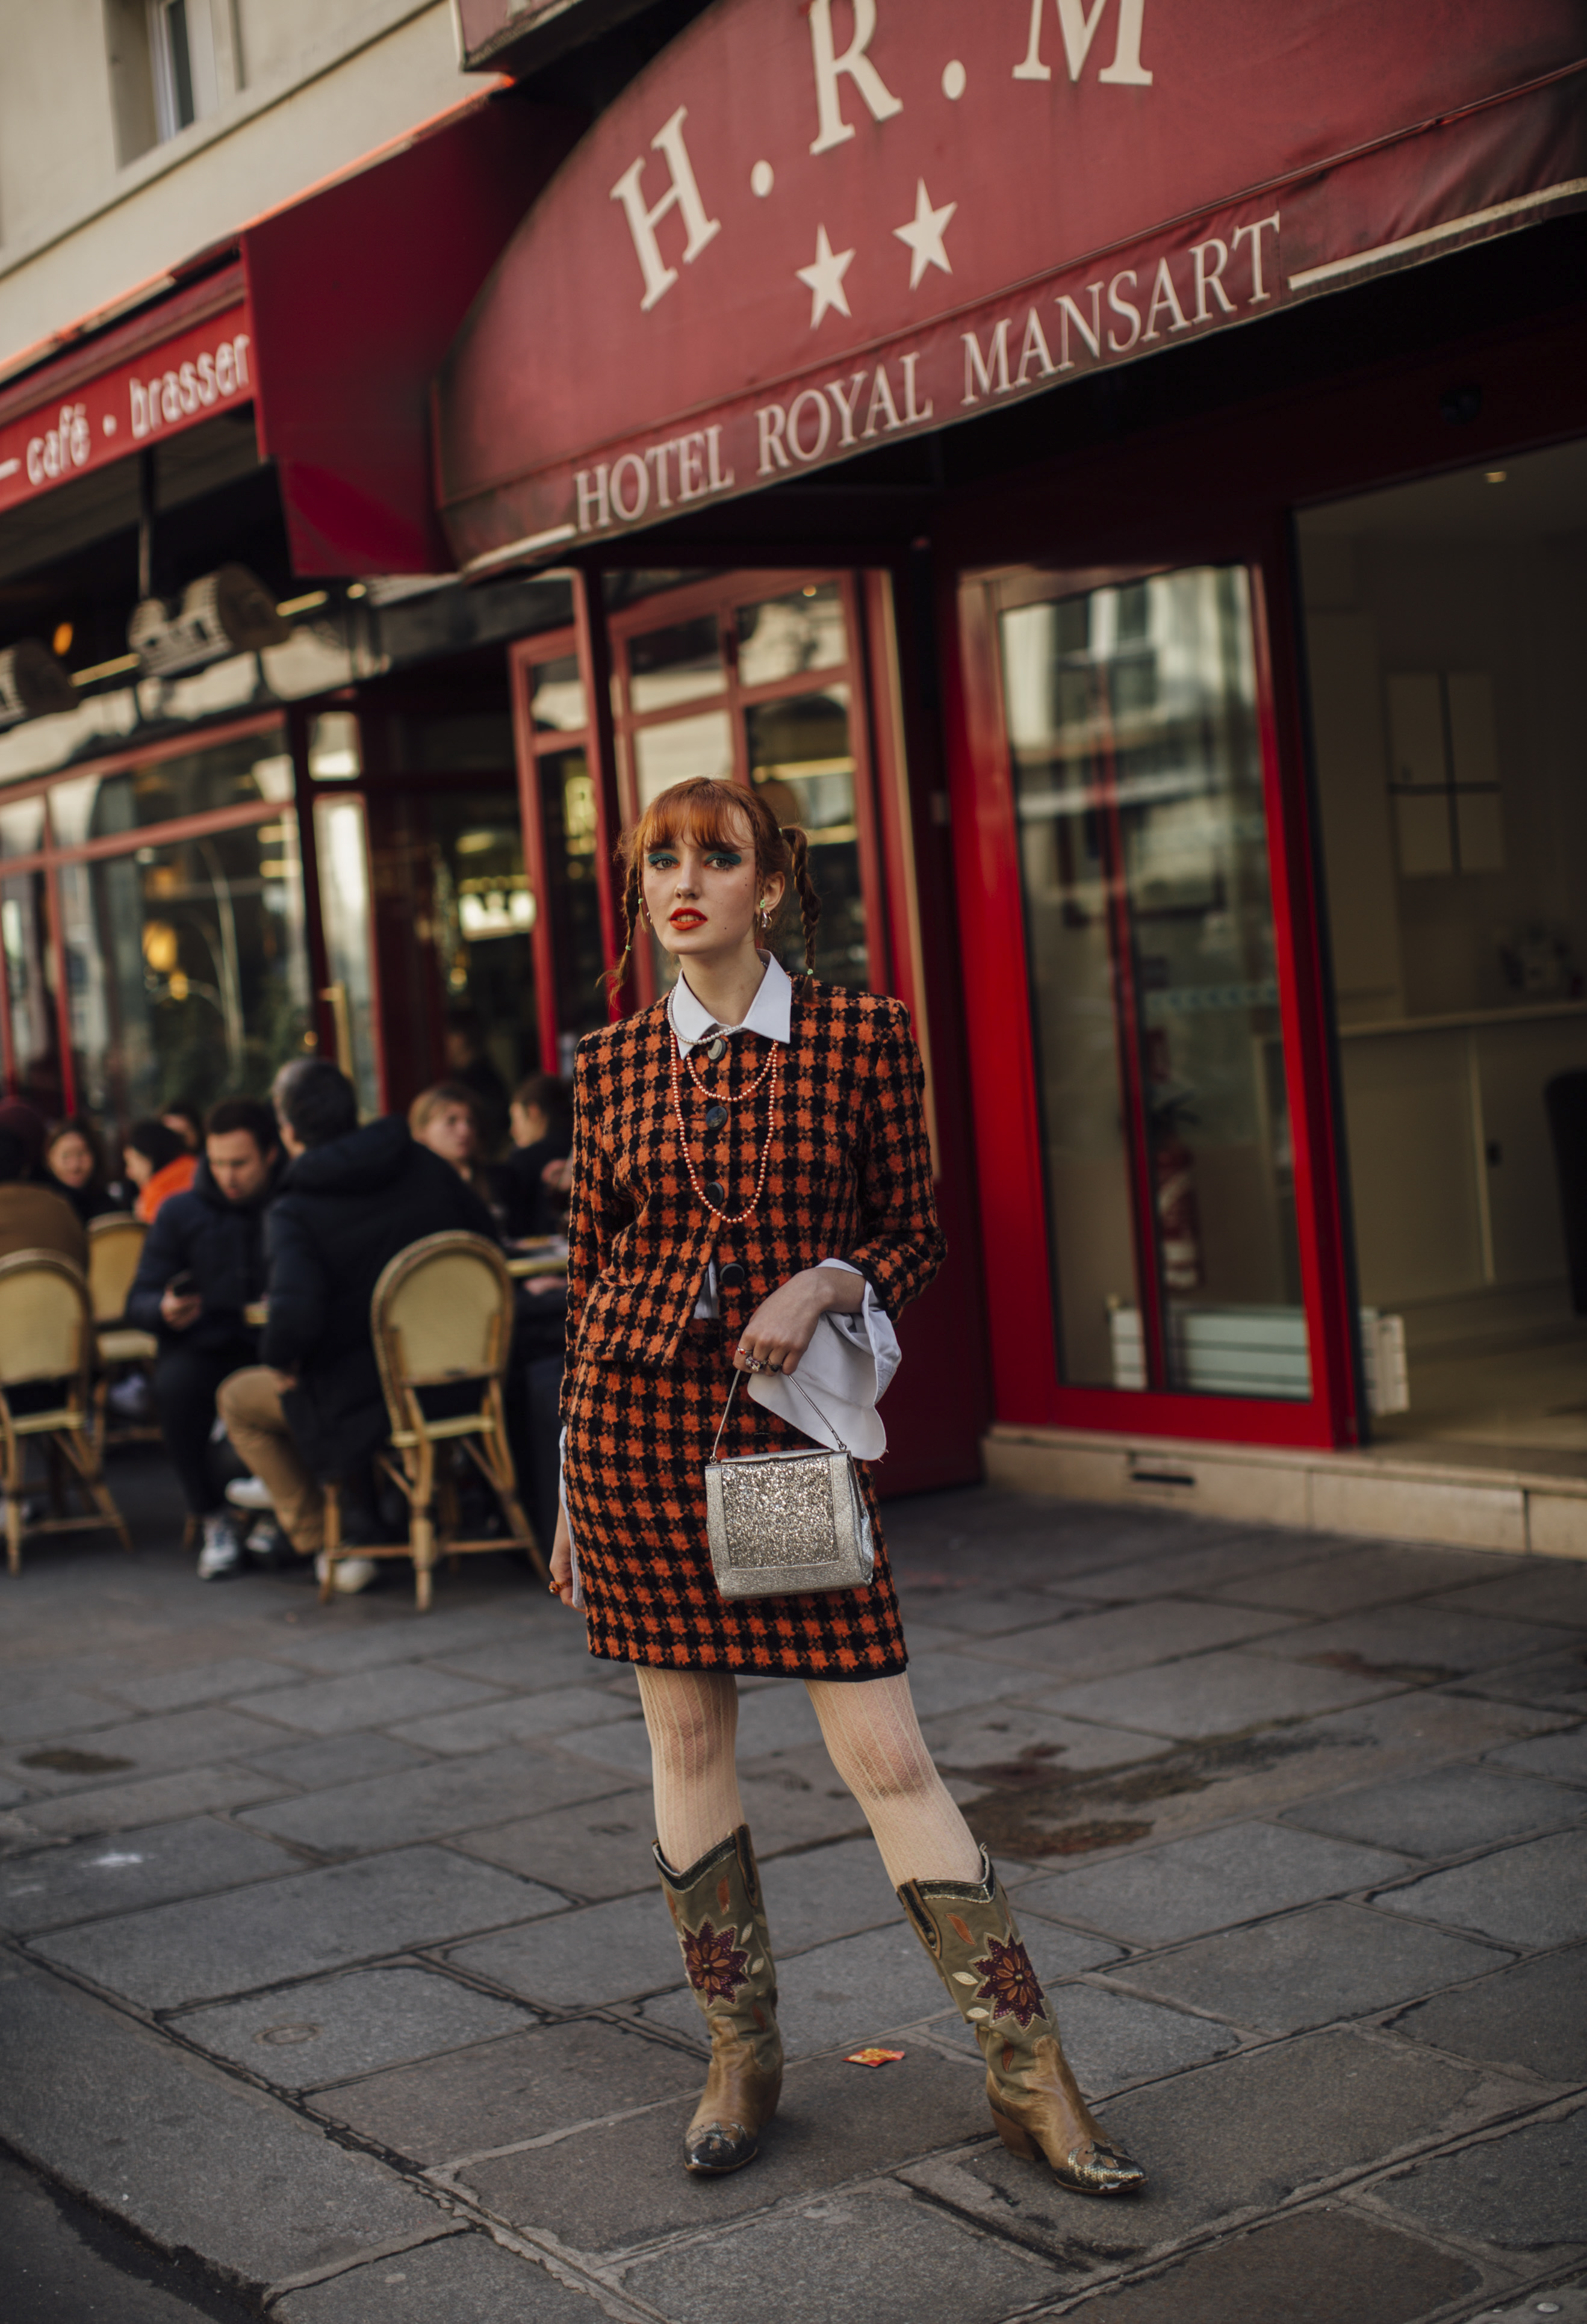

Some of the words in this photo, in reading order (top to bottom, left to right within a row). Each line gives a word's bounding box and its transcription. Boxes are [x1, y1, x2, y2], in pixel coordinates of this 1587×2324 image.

[26, 403, 90, 486] café
[574, 424, 734, 532] HOTEL
[755, 352, 933, 475] ROYAL
[960, 211, 1281, 405] MANSART
